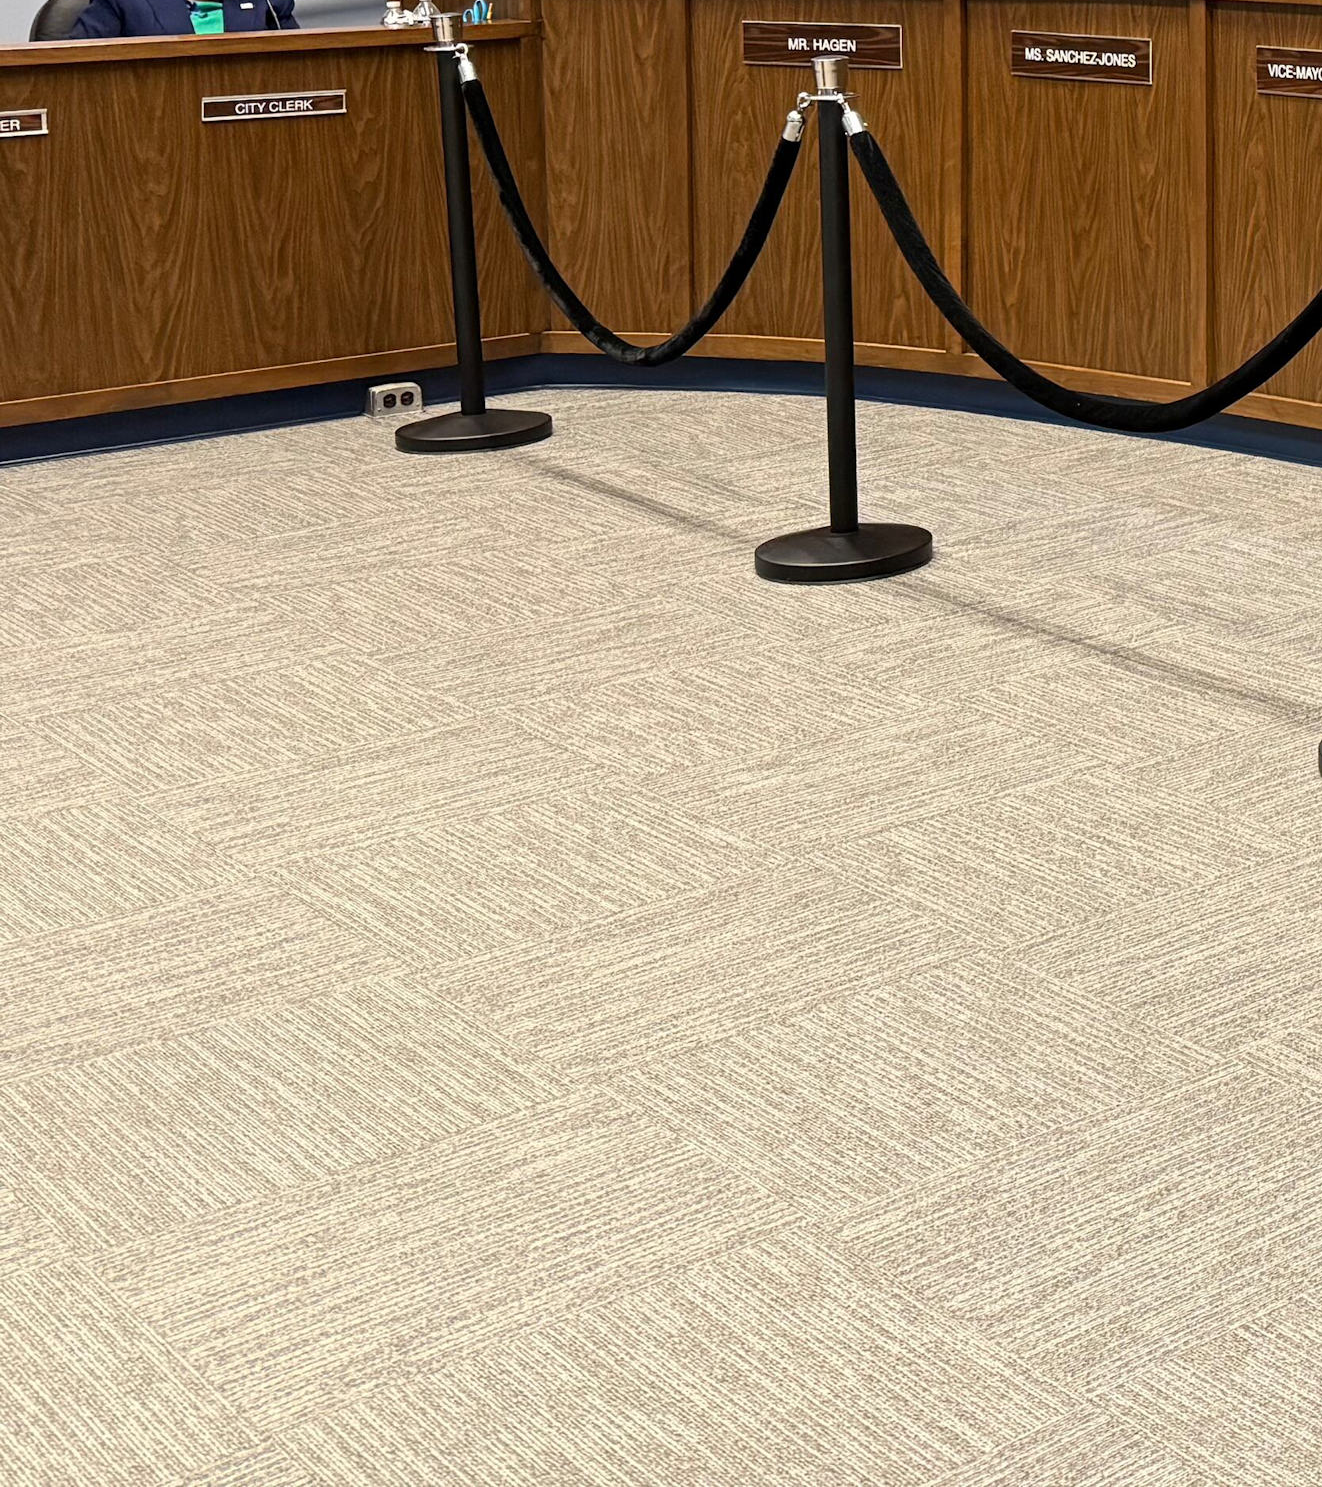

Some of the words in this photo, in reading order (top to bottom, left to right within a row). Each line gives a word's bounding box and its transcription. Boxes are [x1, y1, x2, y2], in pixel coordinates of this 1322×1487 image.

[787, 37, 809, 51] MR.
[813, 38, 857, 52] HAGEN
[1025, 47, 1044, 61] MS.
[1046, 48, 1137, 68] SANCHEZ-JONES
[234, 102, 266, 115] CITY
[269, 99, 314, 113] CLERK
